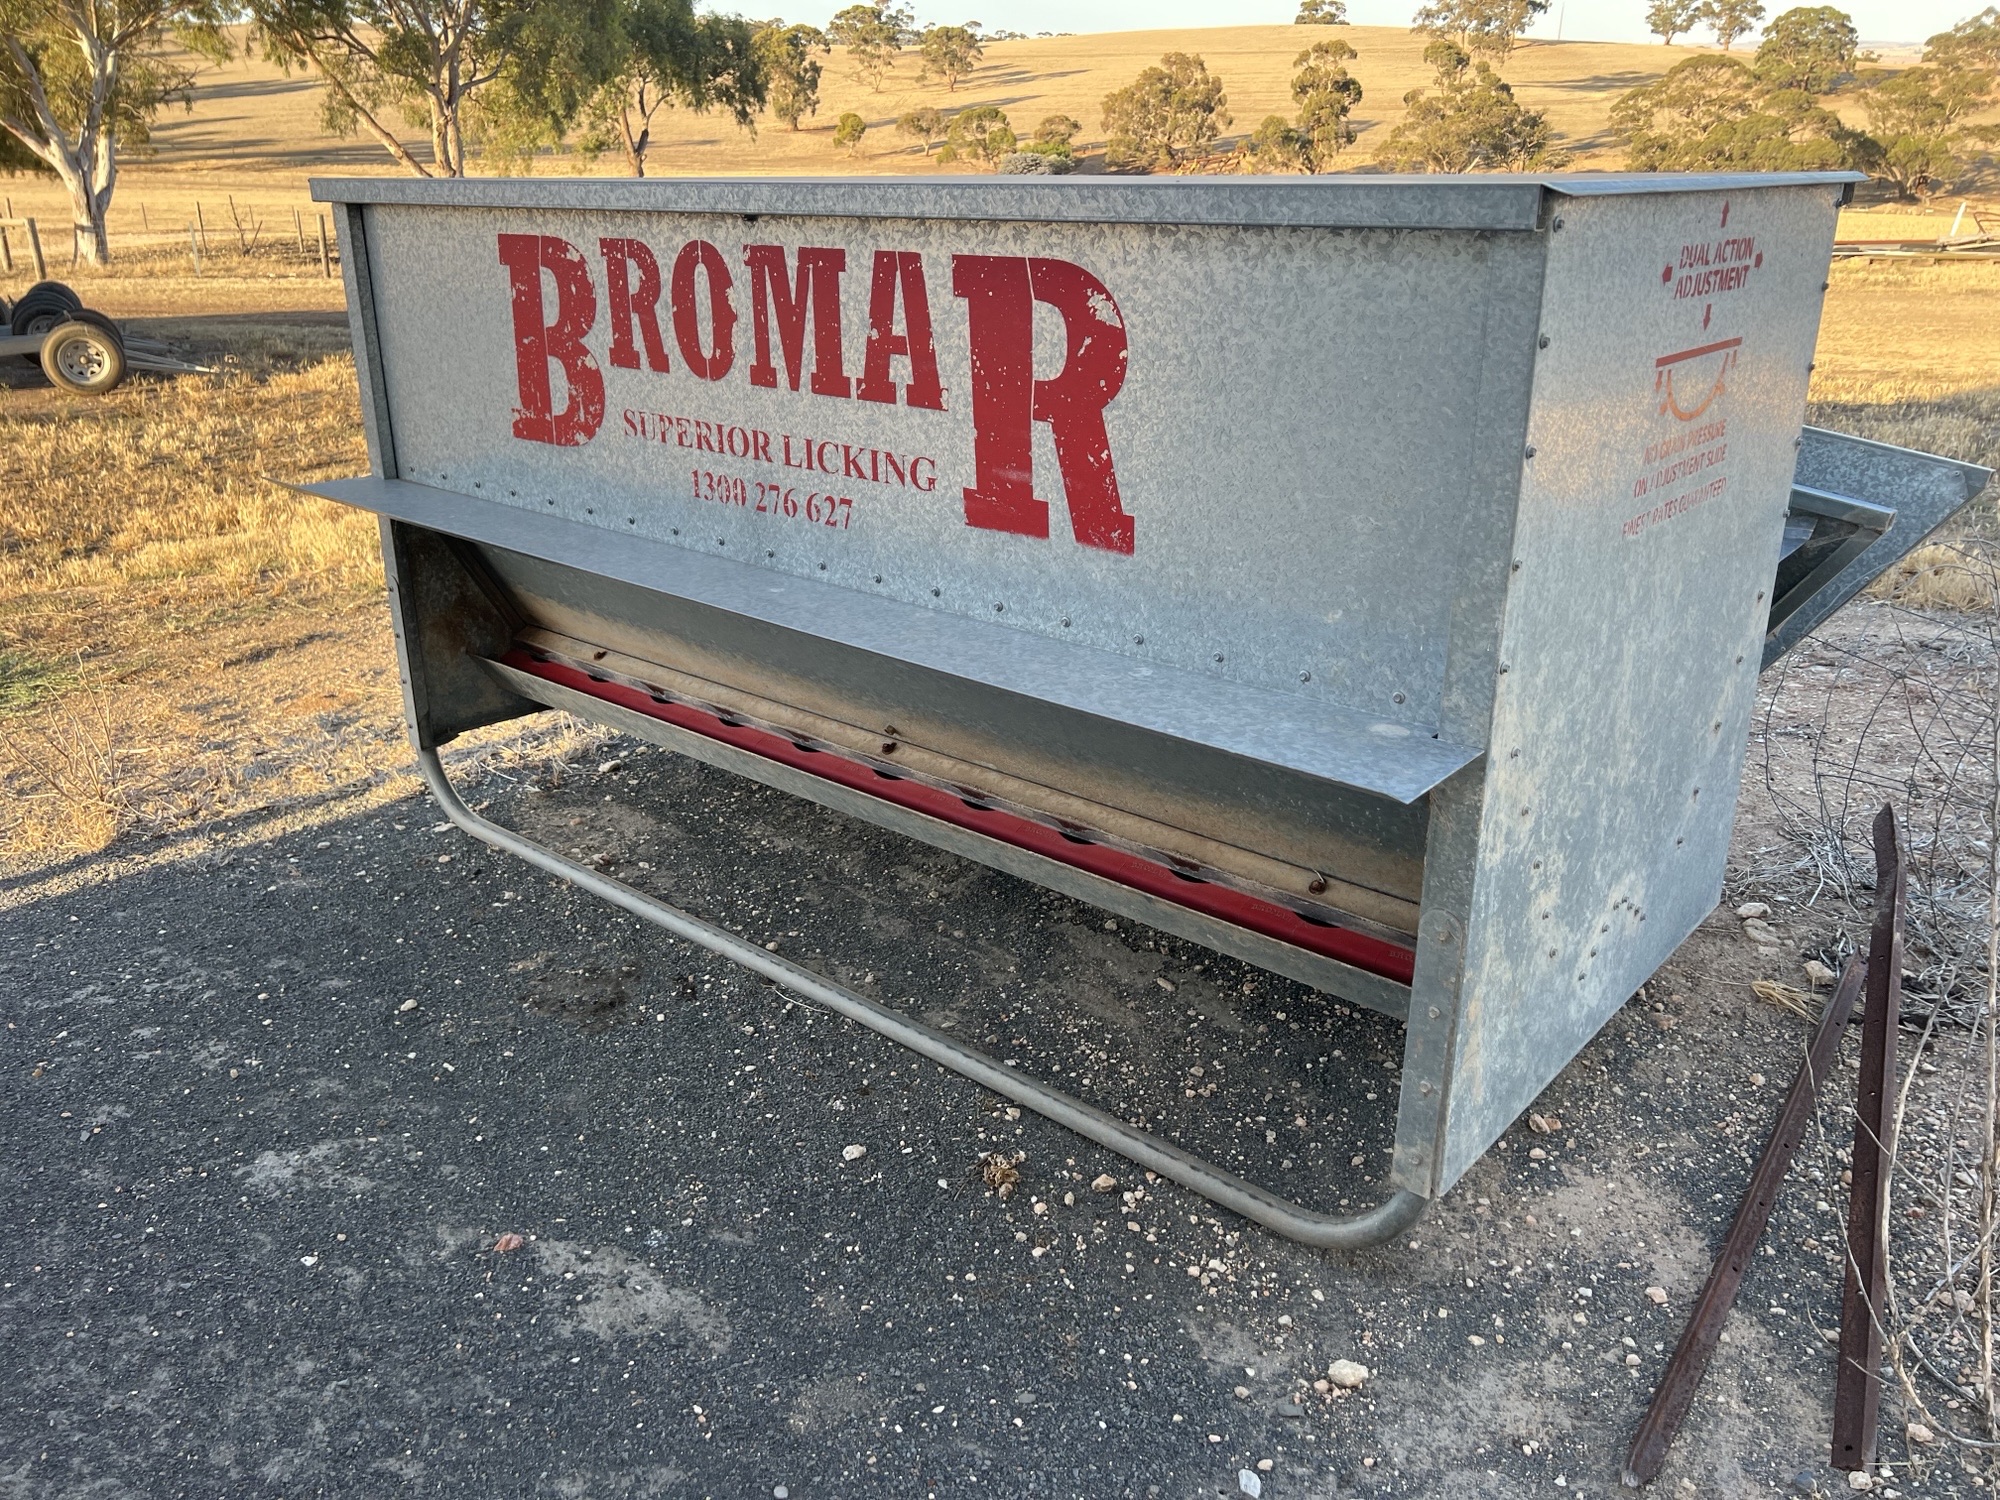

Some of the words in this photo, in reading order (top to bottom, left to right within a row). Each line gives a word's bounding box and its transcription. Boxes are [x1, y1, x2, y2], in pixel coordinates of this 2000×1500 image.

[1679, 242, 1710, 270] DUAL
[1713, 237, 1755, 265] ACTION
[1674, 264, 1750, 300] ADJUSTMENT
[497, 233, 1135, 557] BROMAR
[623, 408, 773, 463] SUPERIOR
[781, 434, 937, 492] LICKING
[1634, 476, 1649, 498] ON
[1706, 442, 1728, 468] SLIDE
[691, 468, 748, 507] 1300
[755, 481, 798, 518] 276
[806, 492, 853, 530] 627
[1387, 949, 1414, 962] BRO
